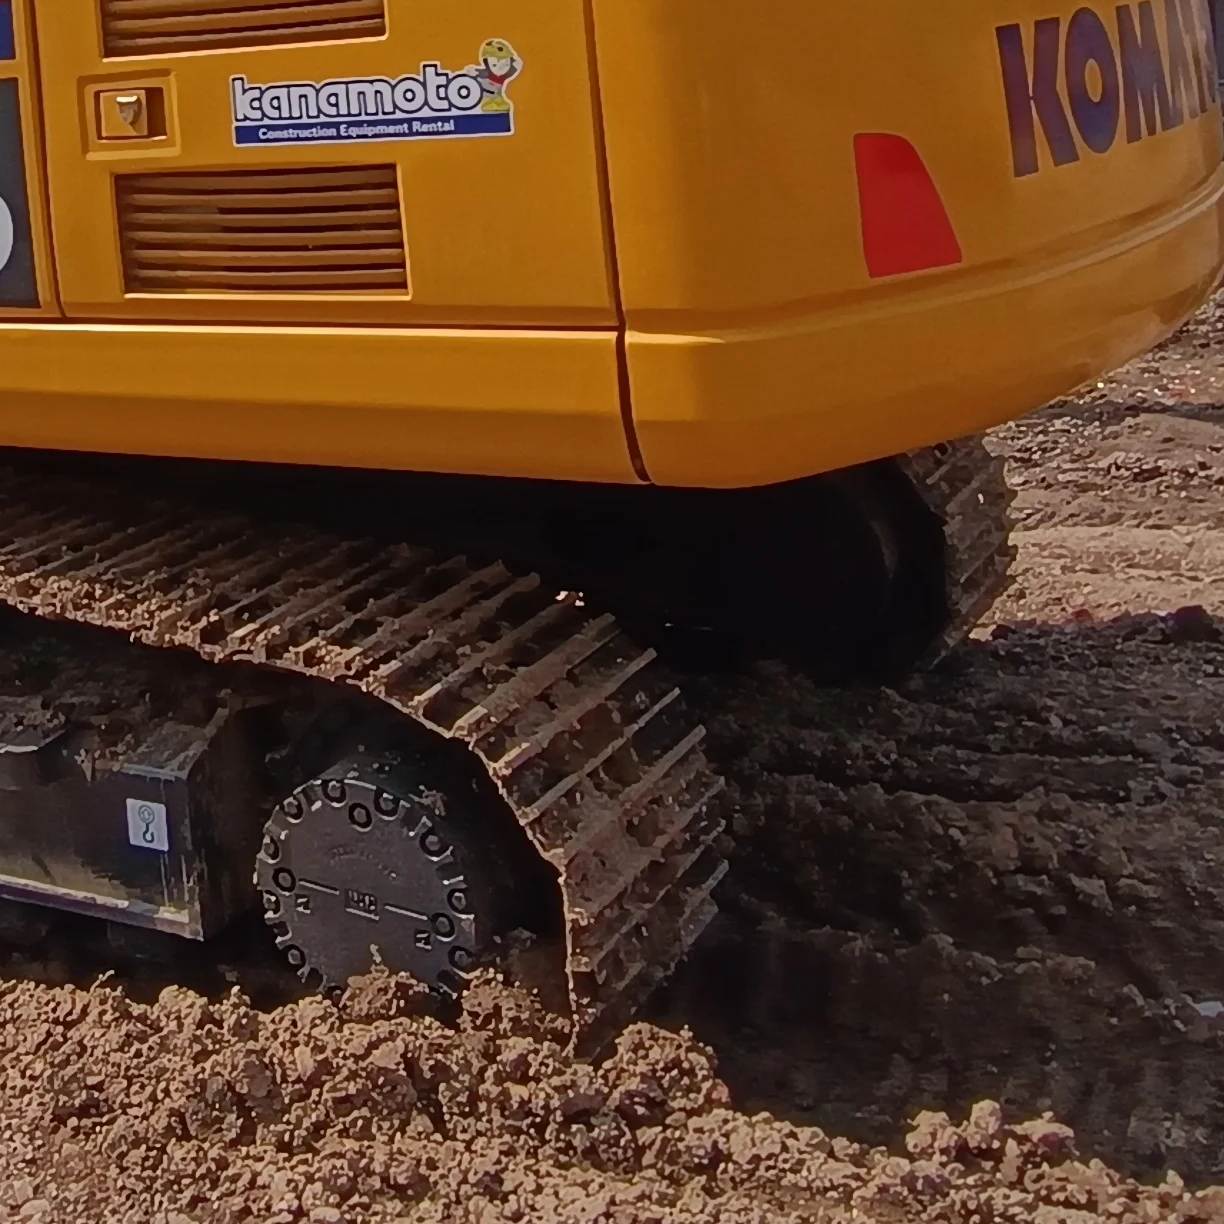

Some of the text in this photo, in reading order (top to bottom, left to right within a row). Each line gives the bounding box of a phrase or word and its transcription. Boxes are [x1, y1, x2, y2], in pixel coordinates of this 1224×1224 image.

[231, 62, 484, 123] kanamoto
[258, 119, 455, 141] Construction Equipment Rental
